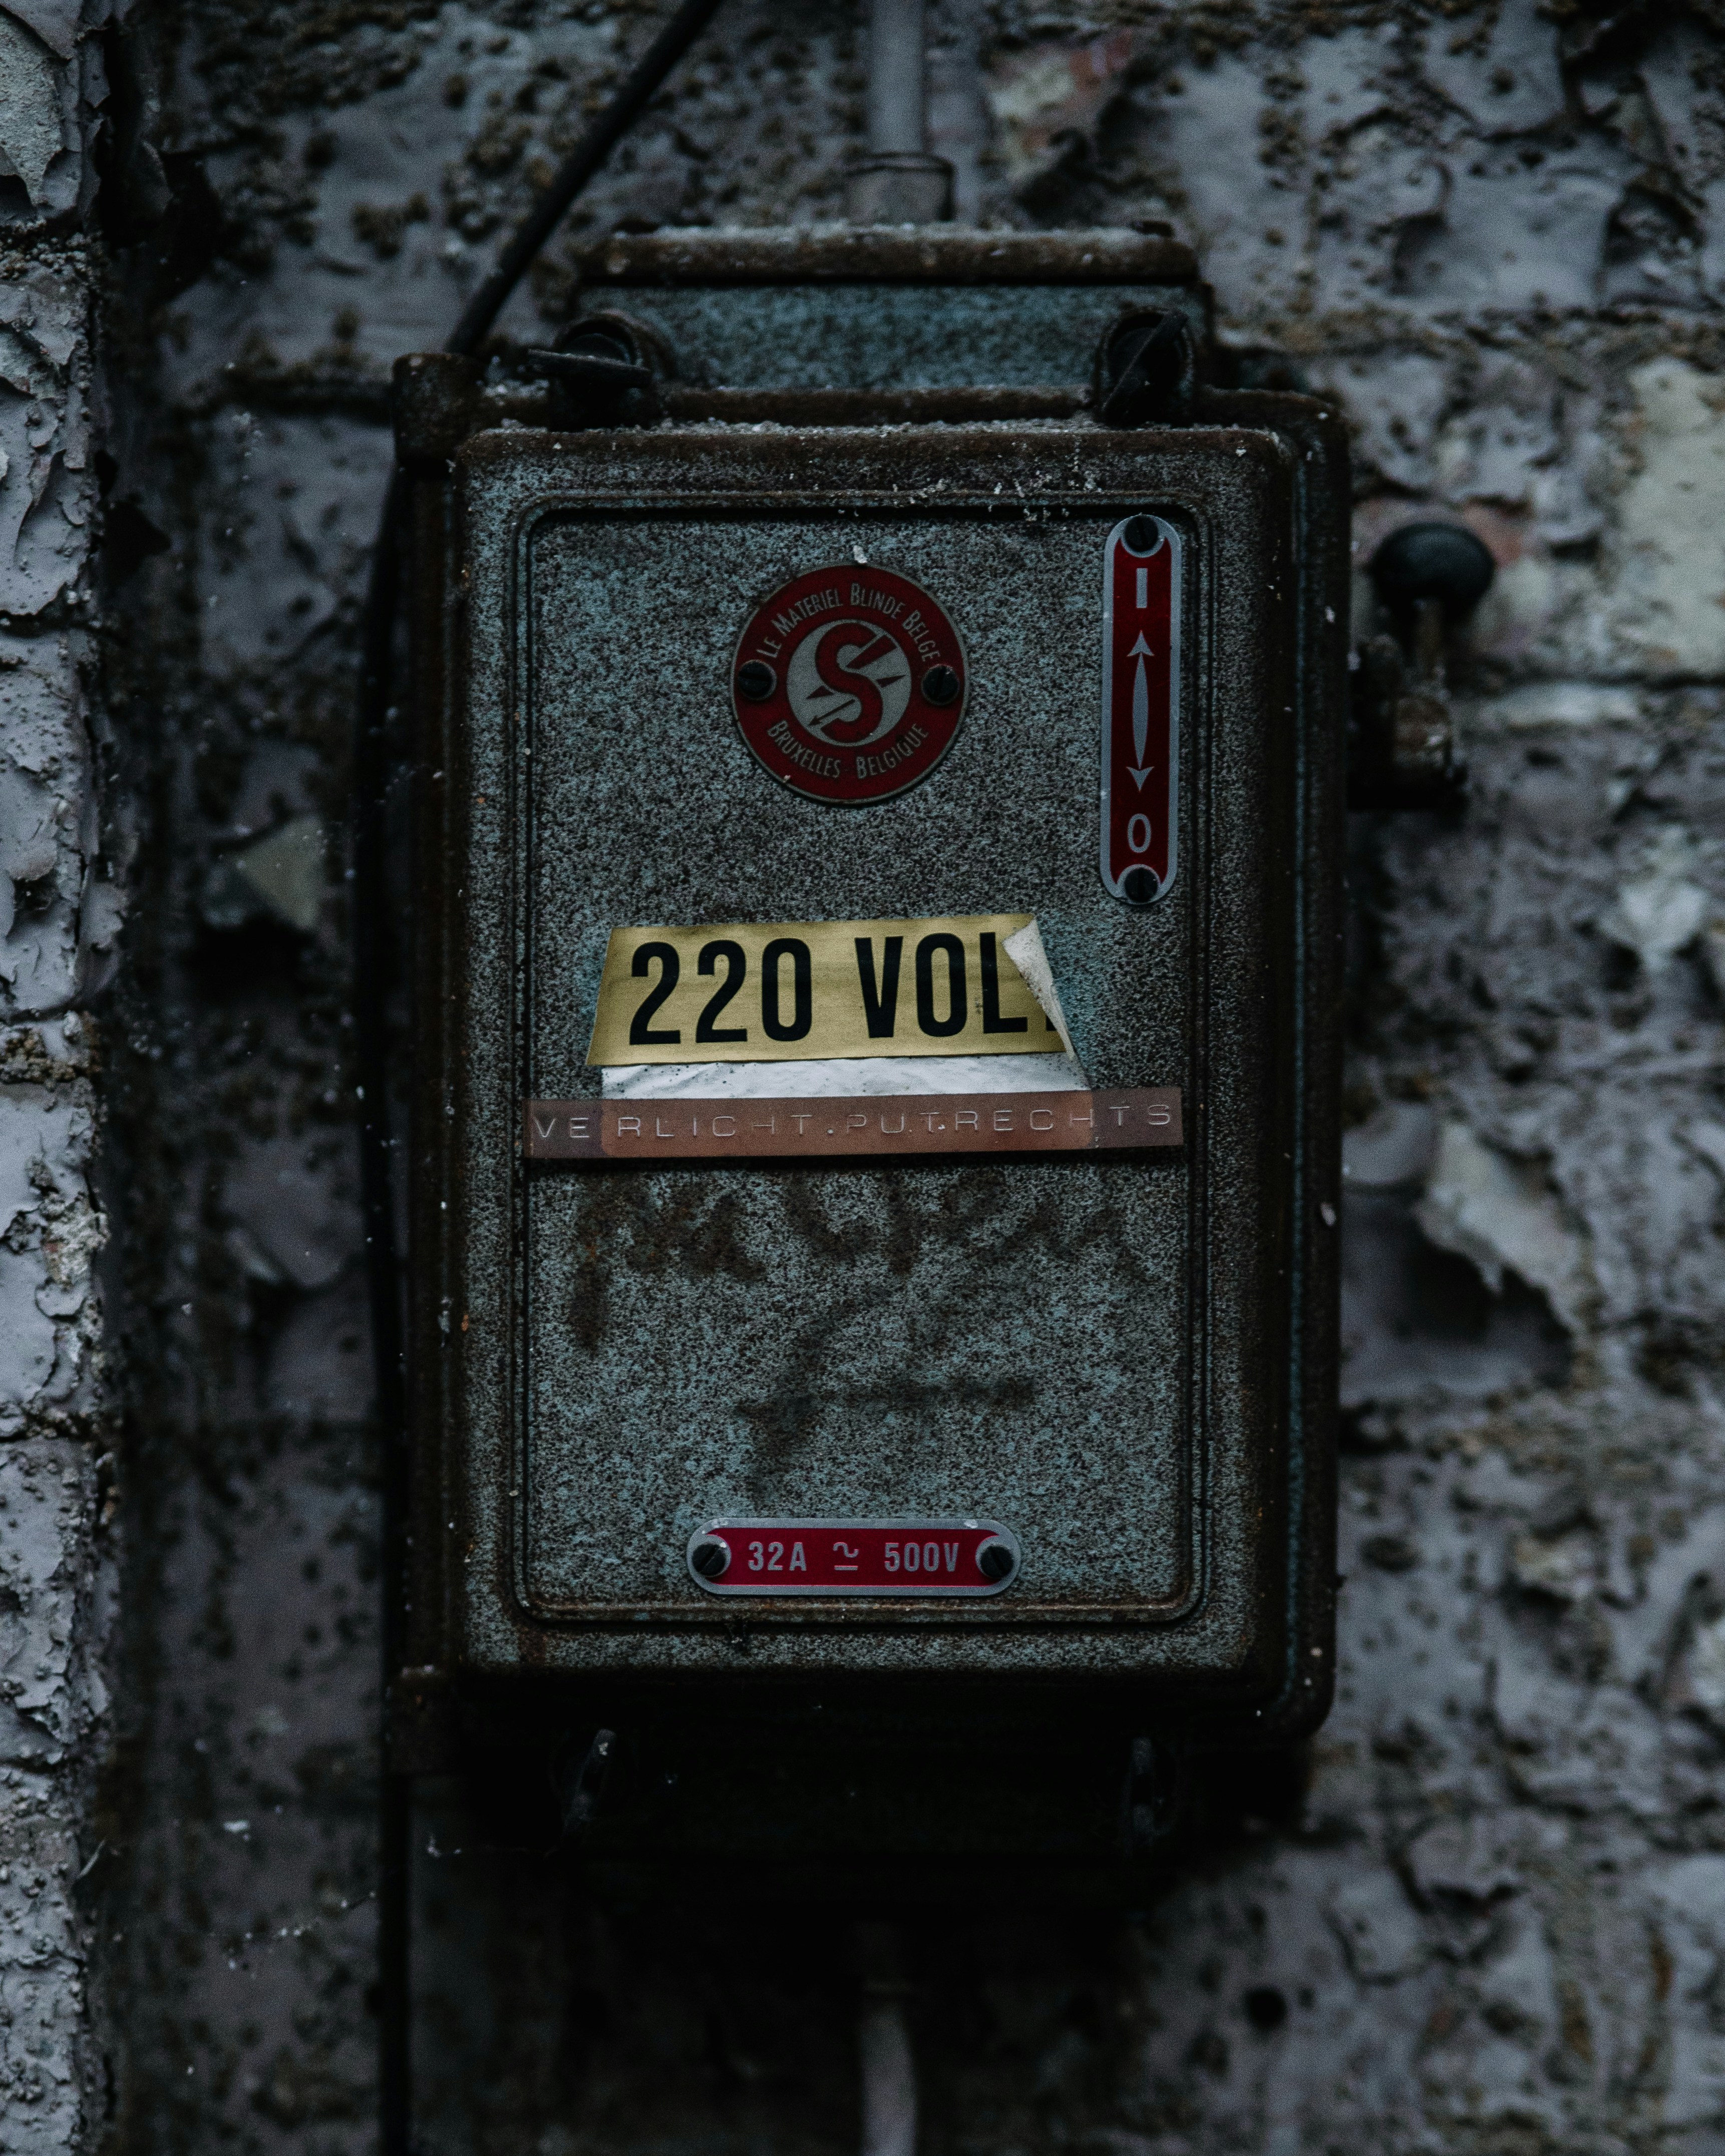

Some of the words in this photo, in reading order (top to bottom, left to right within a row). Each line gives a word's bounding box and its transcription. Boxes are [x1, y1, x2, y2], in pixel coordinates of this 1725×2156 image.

[756, 636, 783, 658] LE
[770, 588, 844, 637] MATERIEL
[850, 582, 906, 619] BLINDE
[902, 609, 941, 662] BELGE
[815, 623, 883, 743] S
[767, 720, 842, 779] BRUXELLES
[856, 723, 929, 779] BELGIQUE
[629, 937, 813, 1045] 220
[854, 931, 1057, 1038] VOL
[748, 1541, 807, 1572] 32A
[884, 1542, 960, 1572] 500V
